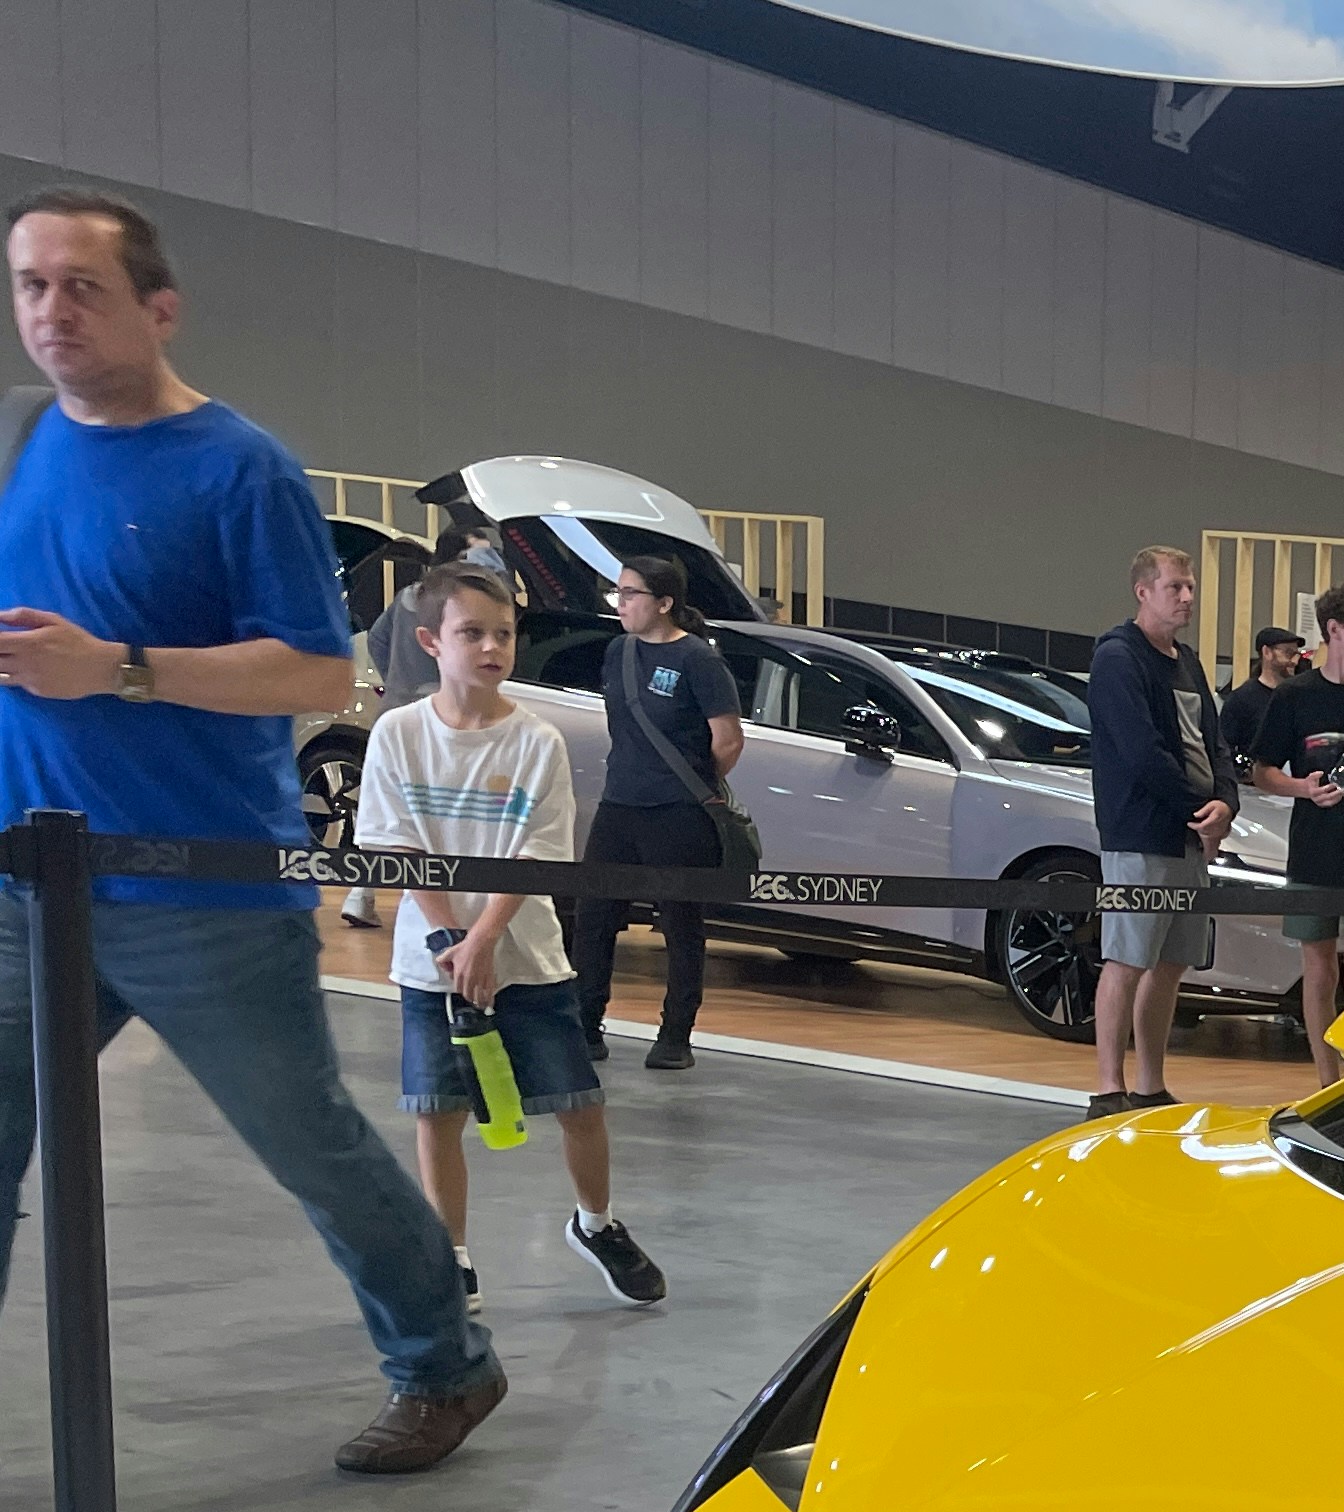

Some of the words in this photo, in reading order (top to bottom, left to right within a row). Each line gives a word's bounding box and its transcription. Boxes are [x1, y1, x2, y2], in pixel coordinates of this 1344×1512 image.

[343, 853, 460, 887] SYDNEY
[797, 875, 883, 902] SYDNEY
[1131, 887, 1197, 911] SYDNEY
